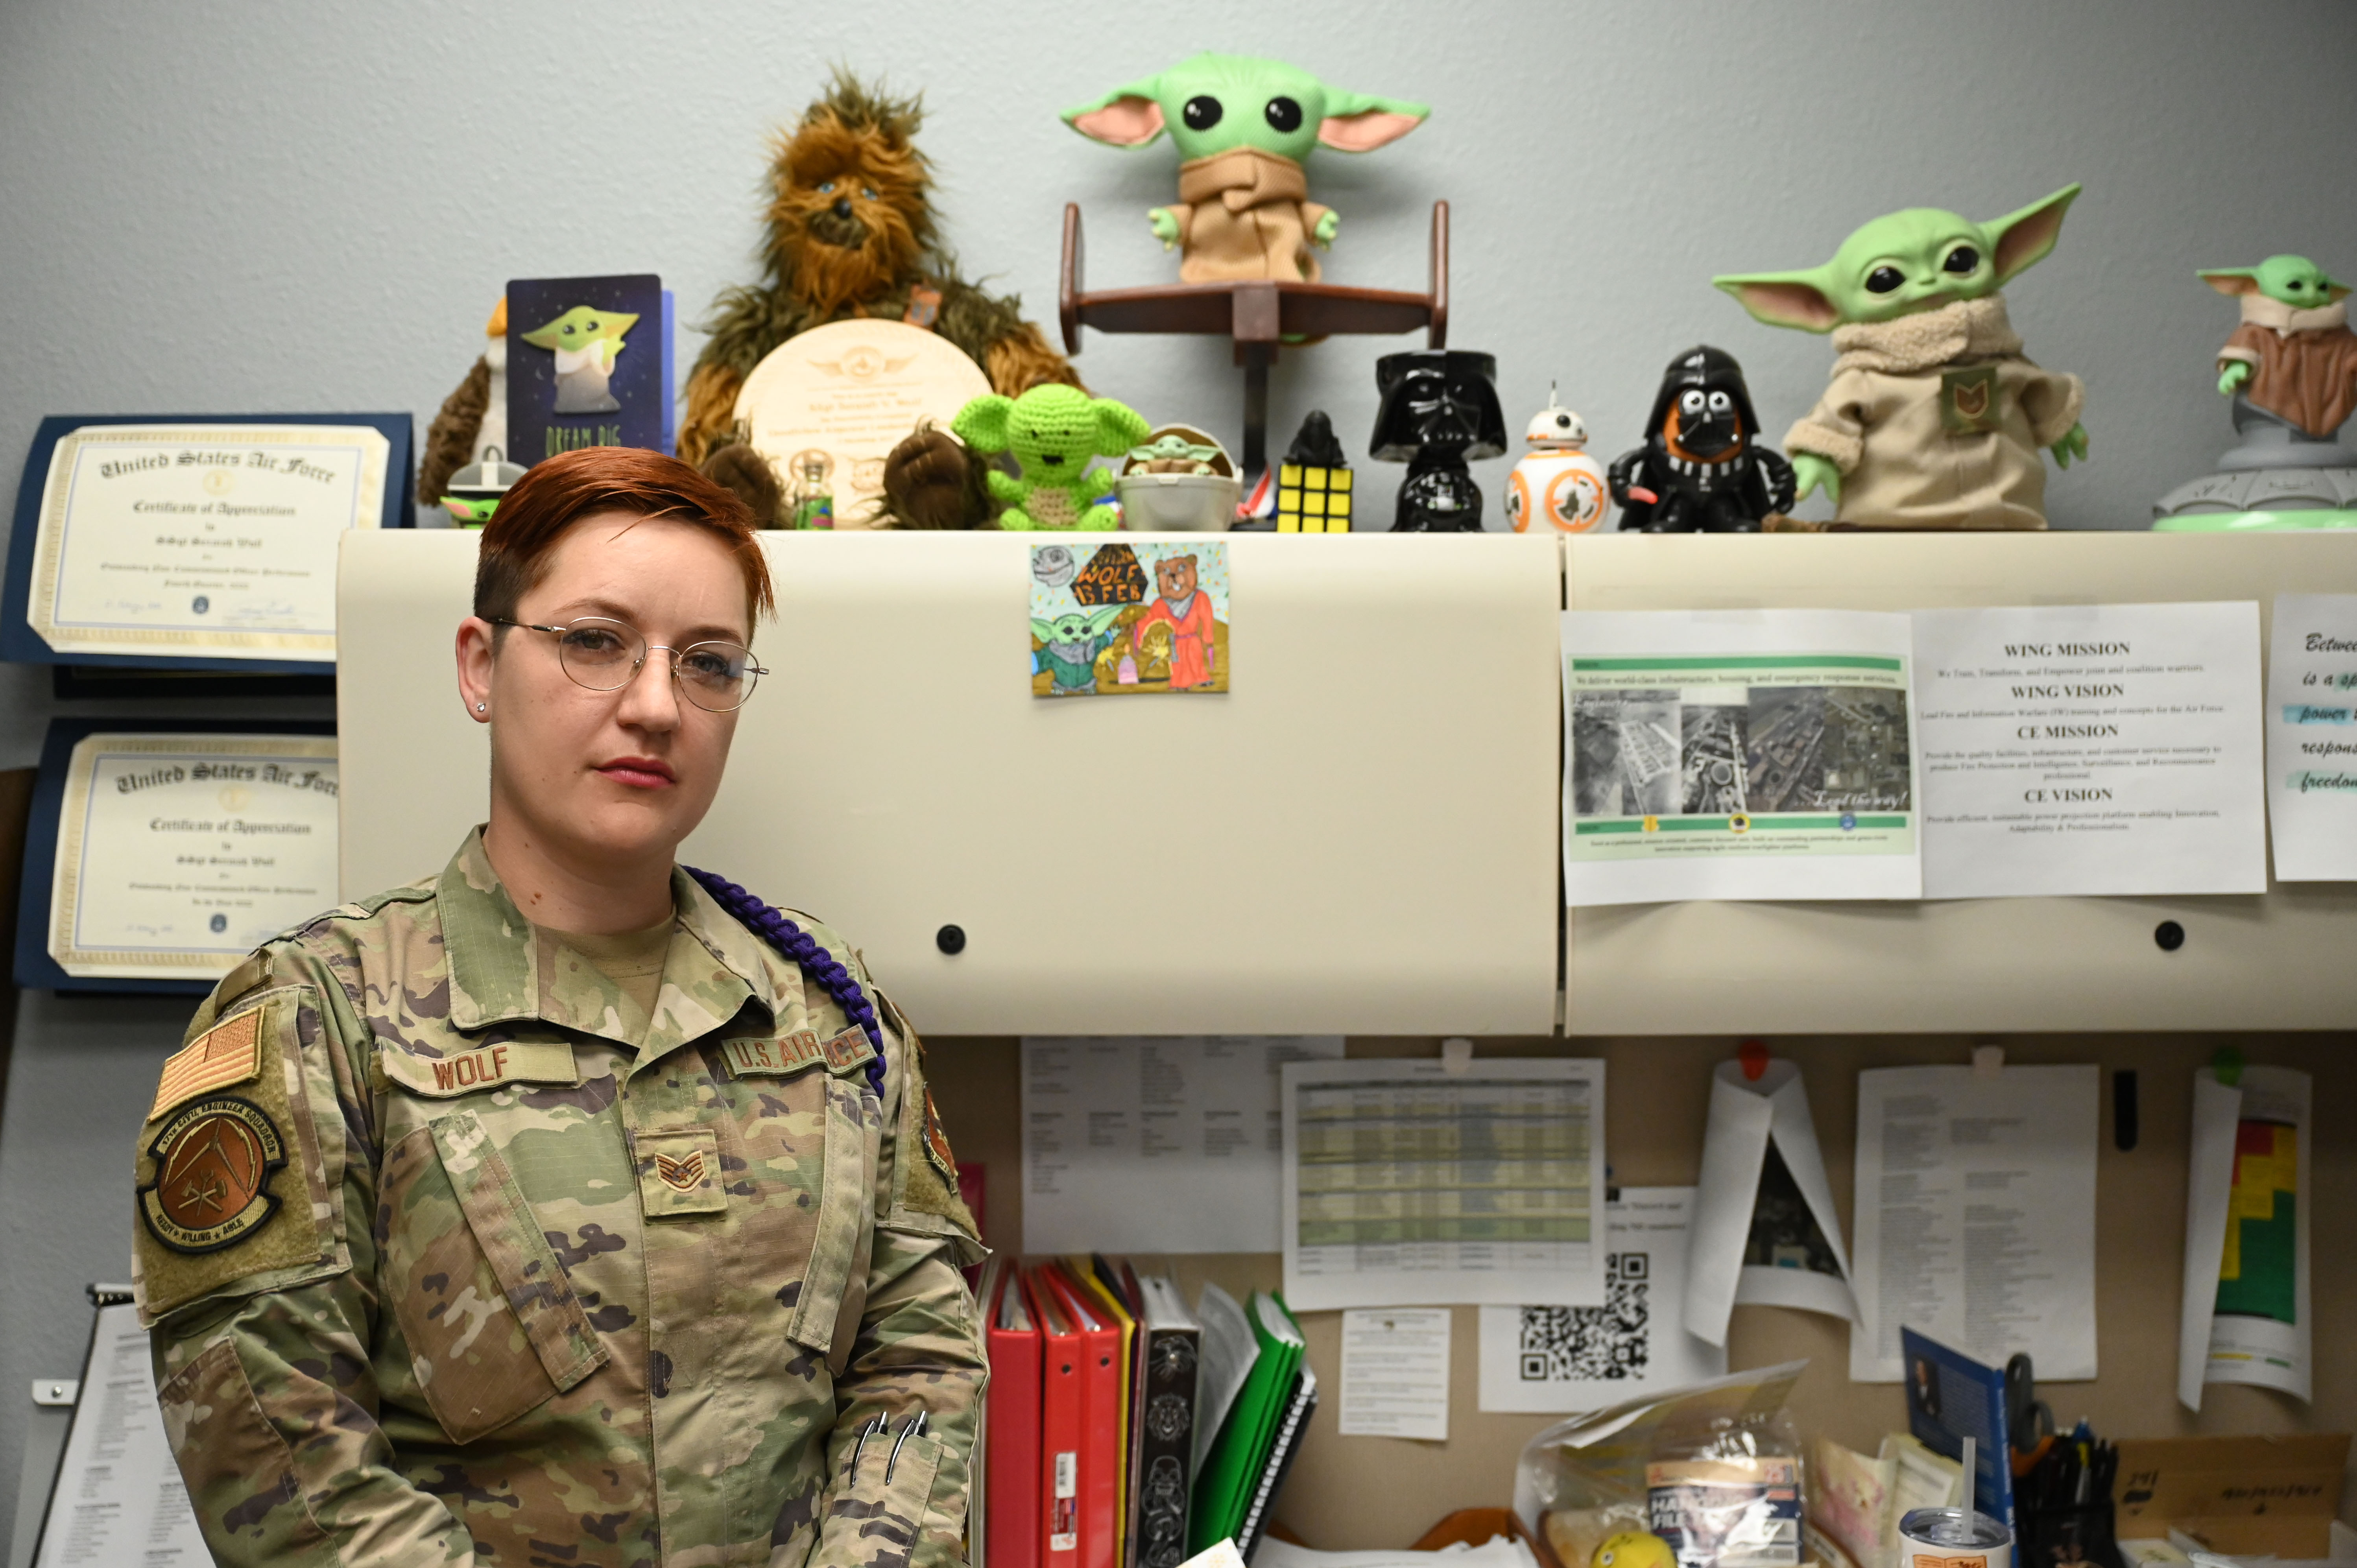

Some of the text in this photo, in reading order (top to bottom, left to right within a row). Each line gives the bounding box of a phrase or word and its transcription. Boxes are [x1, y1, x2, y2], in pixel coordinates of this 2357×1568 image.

[101, 450, 336, 484] United States Air Force
[1077, 564, 1139, 585] WOLF
[1102, 583, 1141, 603] FEB
[2004, 641, 2130, 657] WING MISSION
[2303, 671, 2317, 686] is
[2323, 673, 2333, 686] a
[2011, 683, 2124, 699] WING VISION
[2298, 706, 2347, 724] power
[2017, 723, 2118, 740] CE MISSION
[117, 764, 185, 794] United
[190, 762, 256, 780] States
[261, 763, 294, 785] Air
[2025, 787, 2112, 804] CE VISION
[732, 1042, 779, 1068] U.S.
[778, 1031, 821, 1067] AIR
[432, 1046, 508, 1090] WOLF
[162, 1101, 276, 1153] 17TH CIVIL ENGINEER SQUADRON
[156, 1214, 244, 1242] READY WILLING ABLE
